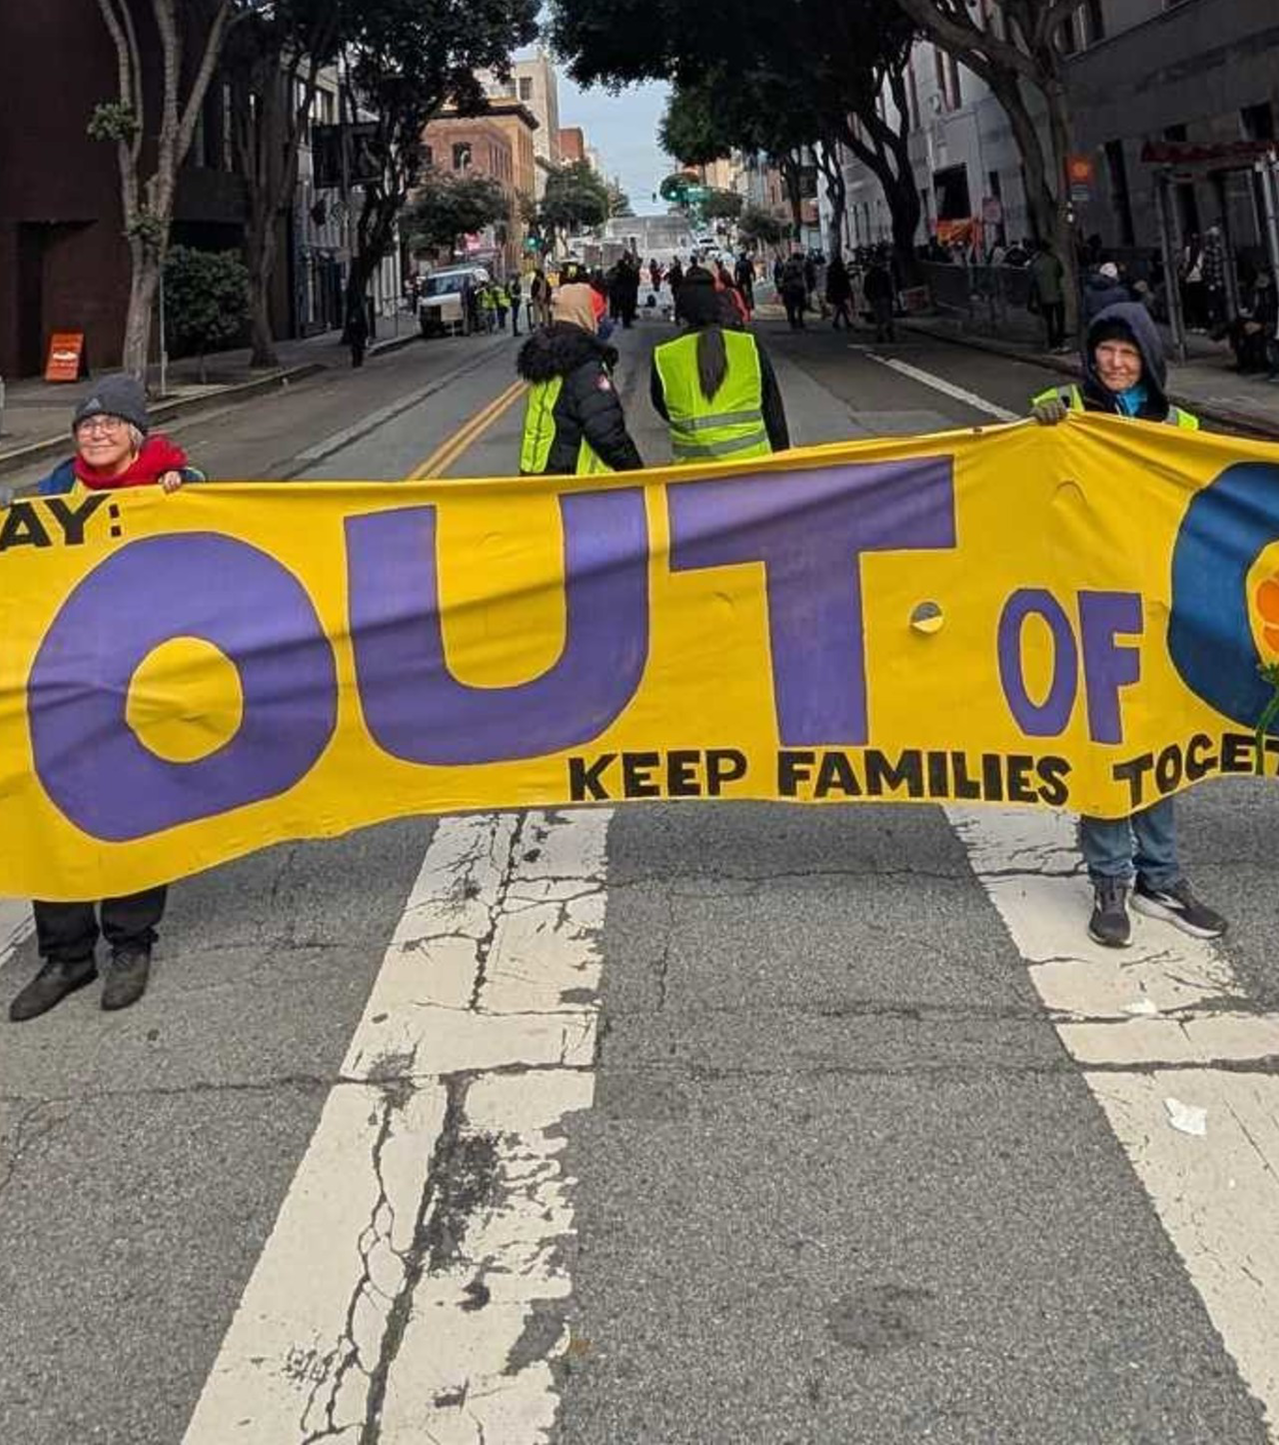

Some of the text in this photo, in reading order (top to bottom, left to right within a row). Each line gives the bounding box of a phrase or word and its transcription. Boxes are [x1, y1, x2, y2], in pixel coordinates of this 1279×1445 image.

[26, 457, 956, 844] OUT
[996, 587, 1144, 745] OF
[567, 747, 748, 803] KEEP
[776, 747, 1072, 808] FAMILIES
